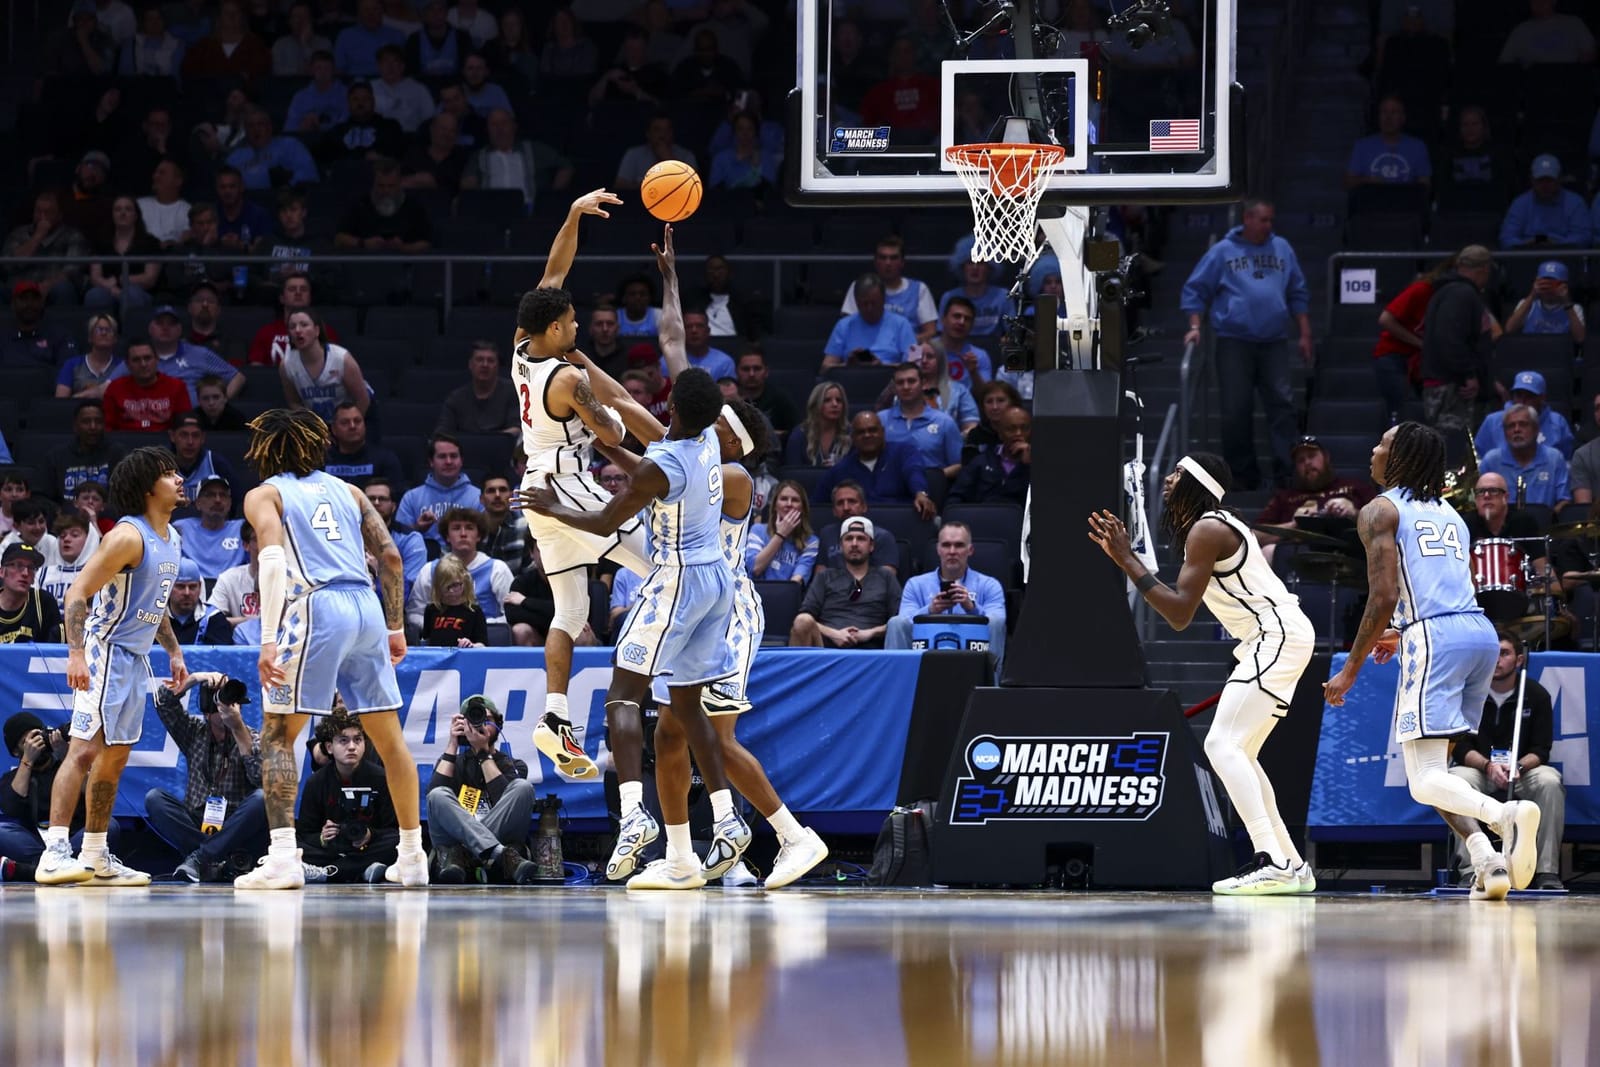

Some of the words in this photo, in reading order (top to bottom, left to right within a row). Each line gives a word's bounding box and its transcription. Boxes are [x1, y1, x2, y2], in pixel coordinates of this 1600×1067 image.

[844, 130, 874, 139] MARCH
[847, 139, 888, 148] MADNESS
[1226, 257, 1249, 272] TAR
[1345, 281, 1371, 292] 109
[520, 384, 532, 428] 2
[707, 465, 722, 505] 9
[310, 503, 342, 541] 4
[1414, 520, 1465, 561] 24
[156, 578, 173, 609] 3
[434, 617, 466, 630] UFC
[974, 754, 1001, 764] NCAA
[1001, 743, 1110, 774] MARCH
[1014, 775, 1161, 806] MADNESS
